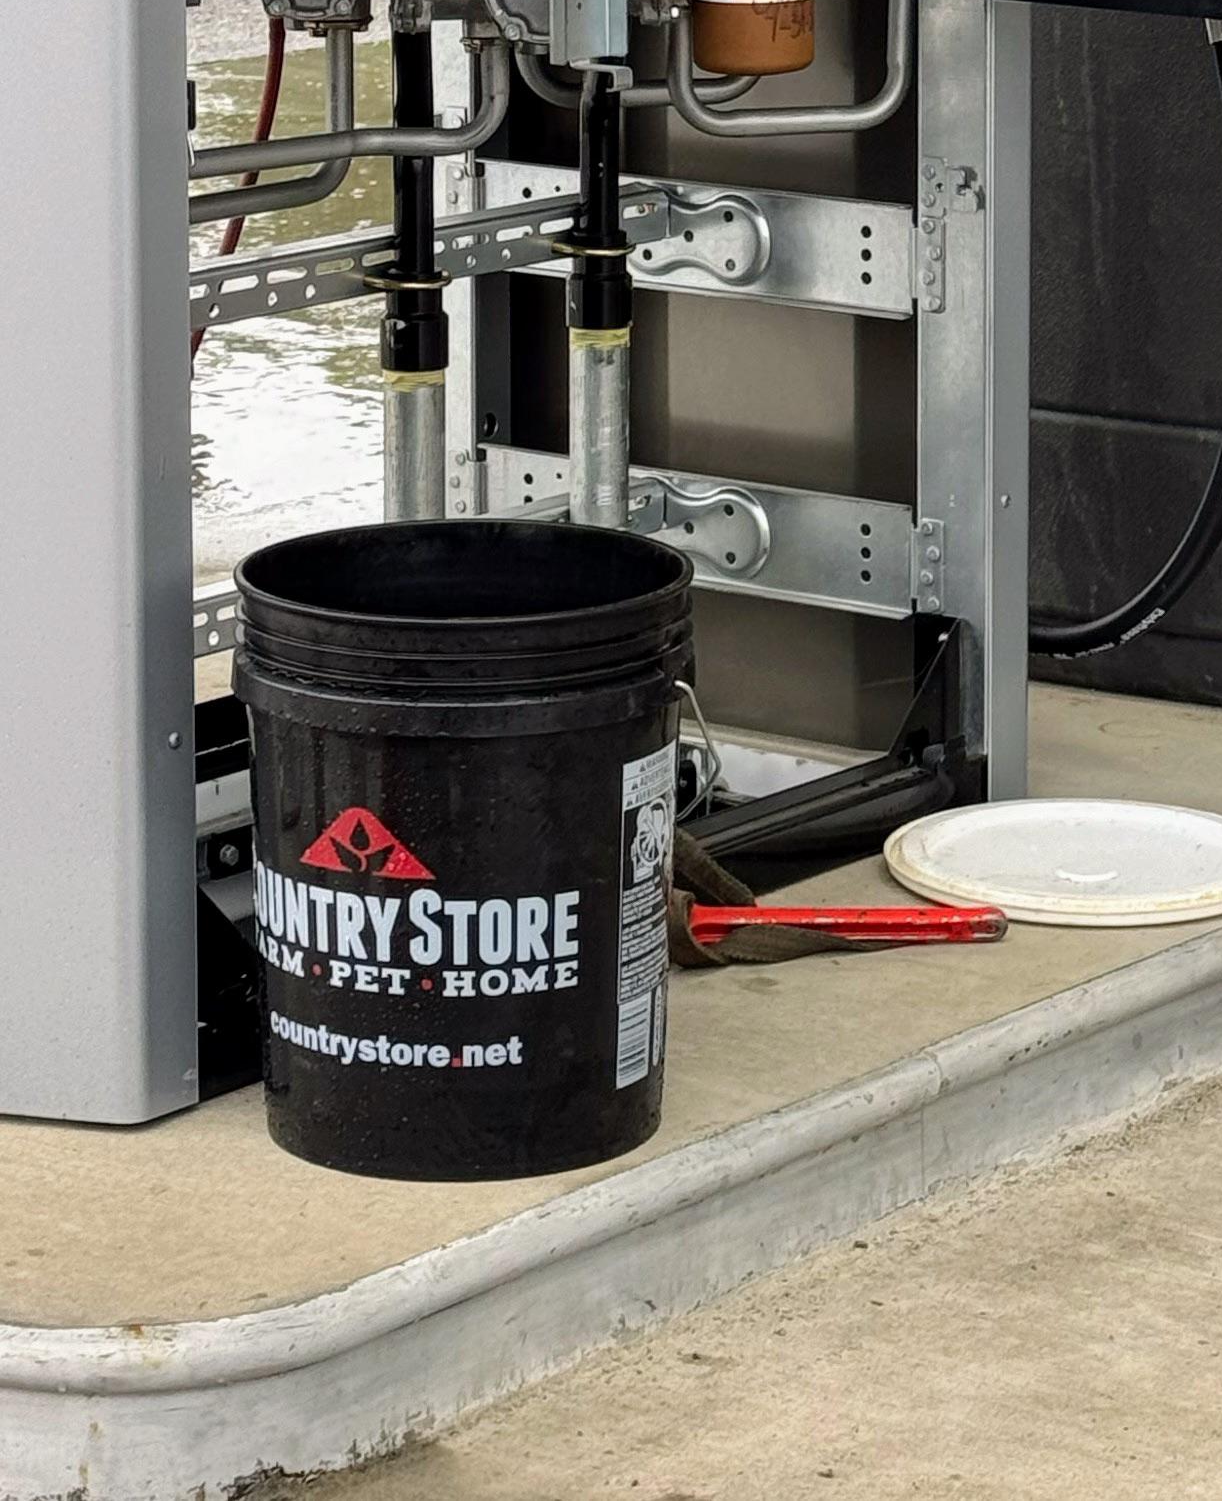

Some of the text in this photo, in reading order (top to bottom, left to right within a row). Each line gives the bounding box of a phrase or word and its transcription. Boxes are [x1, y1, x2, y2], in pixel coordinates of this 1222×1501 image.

[253, 857, 401, 963] OUNTRY
[409, 888, 580, 966] STORE
[256, 928, 579, 997] ARM PET HOME
[270, 1010, 523, 1067] countrystore.net
